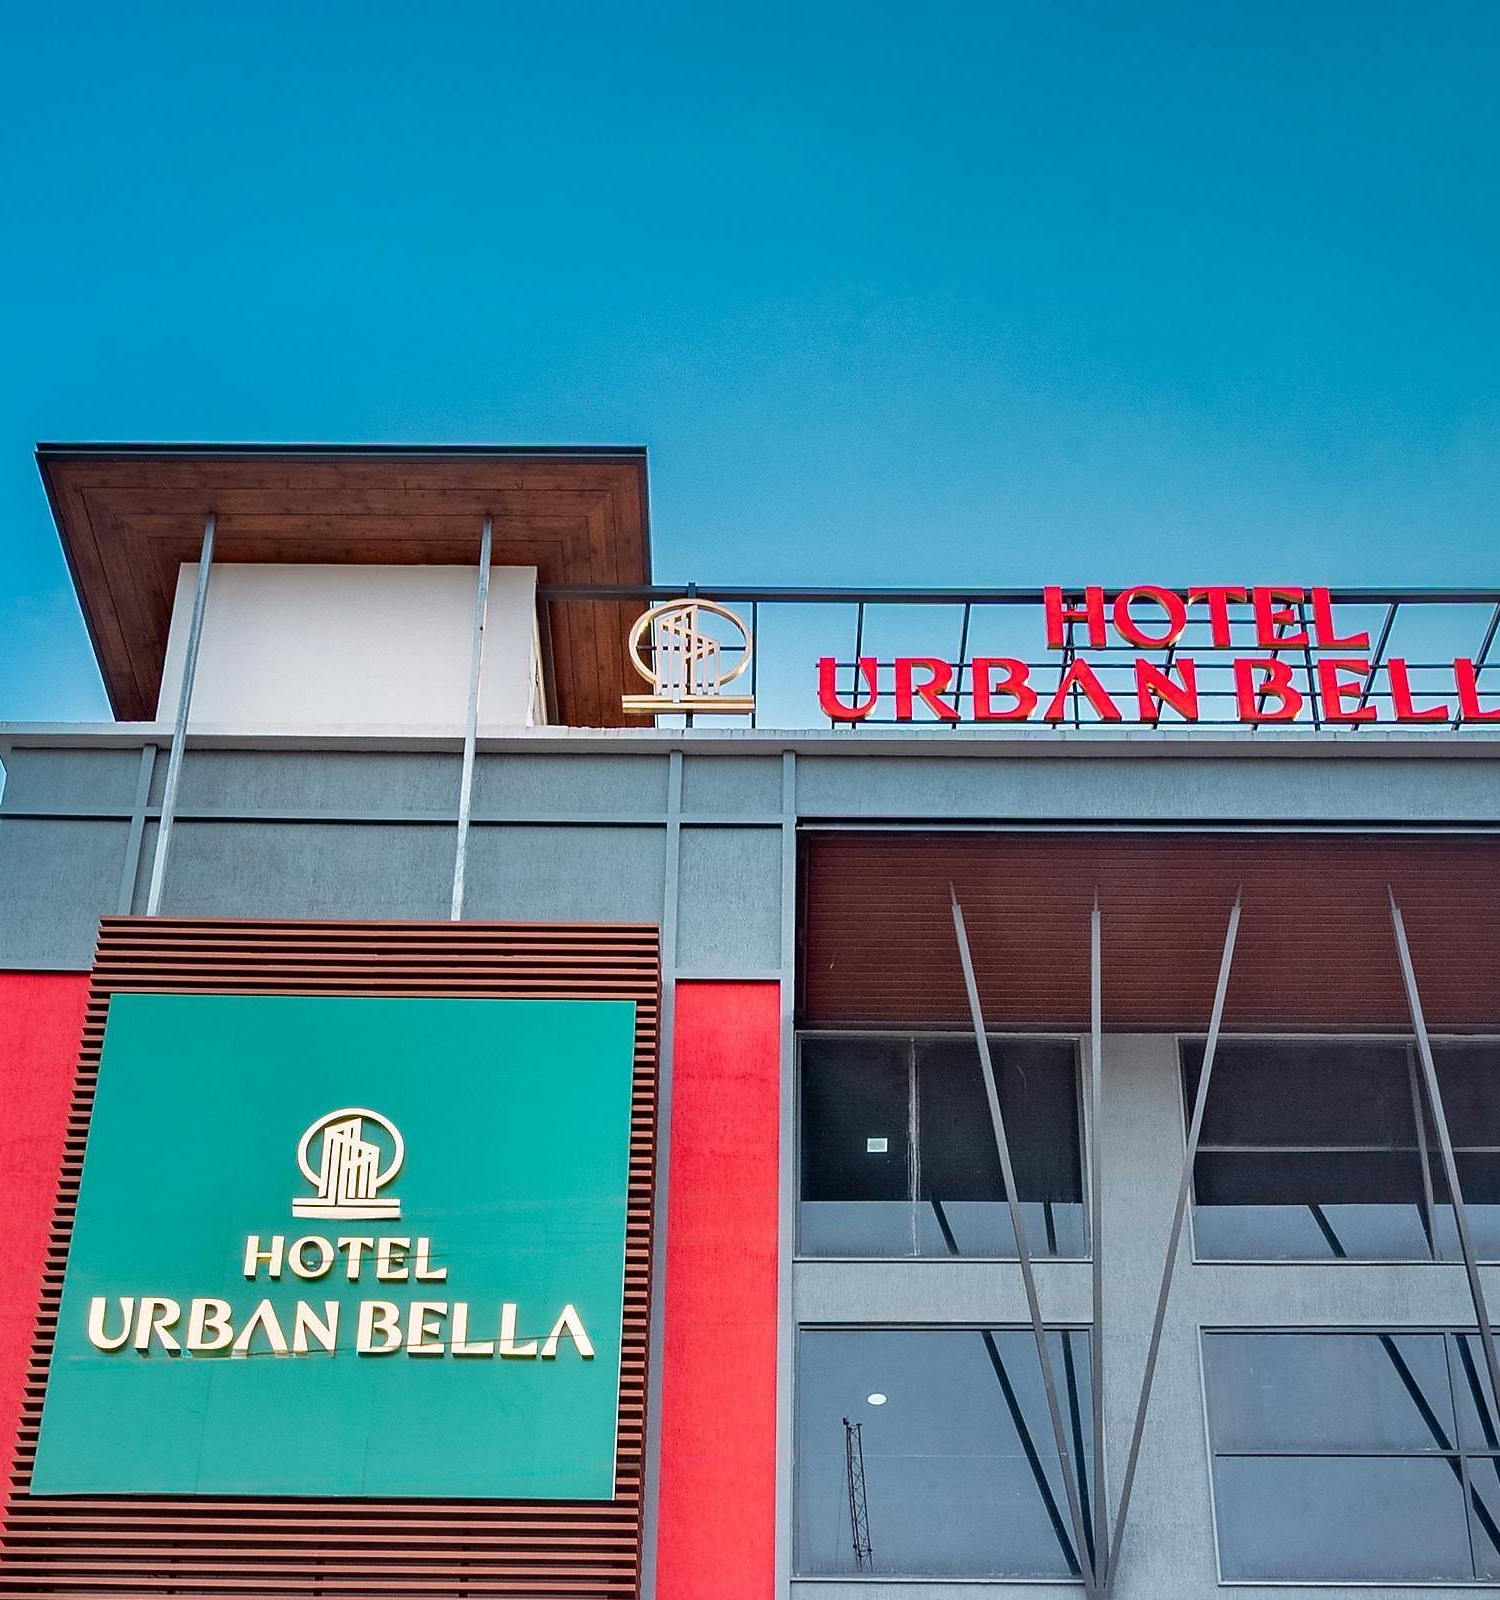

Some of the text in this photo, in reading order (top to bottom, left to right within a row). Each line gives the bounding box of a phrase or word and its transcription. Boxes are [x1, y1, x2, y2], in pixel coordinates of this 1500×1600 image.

[1045, 585, 1370, 650] HOTEL
[817, 655, 1199, 724] URBAN
[244, 1235, 447, 1280] HOTEL
[88, 1296, 594, 1360] URBAN BELLA
